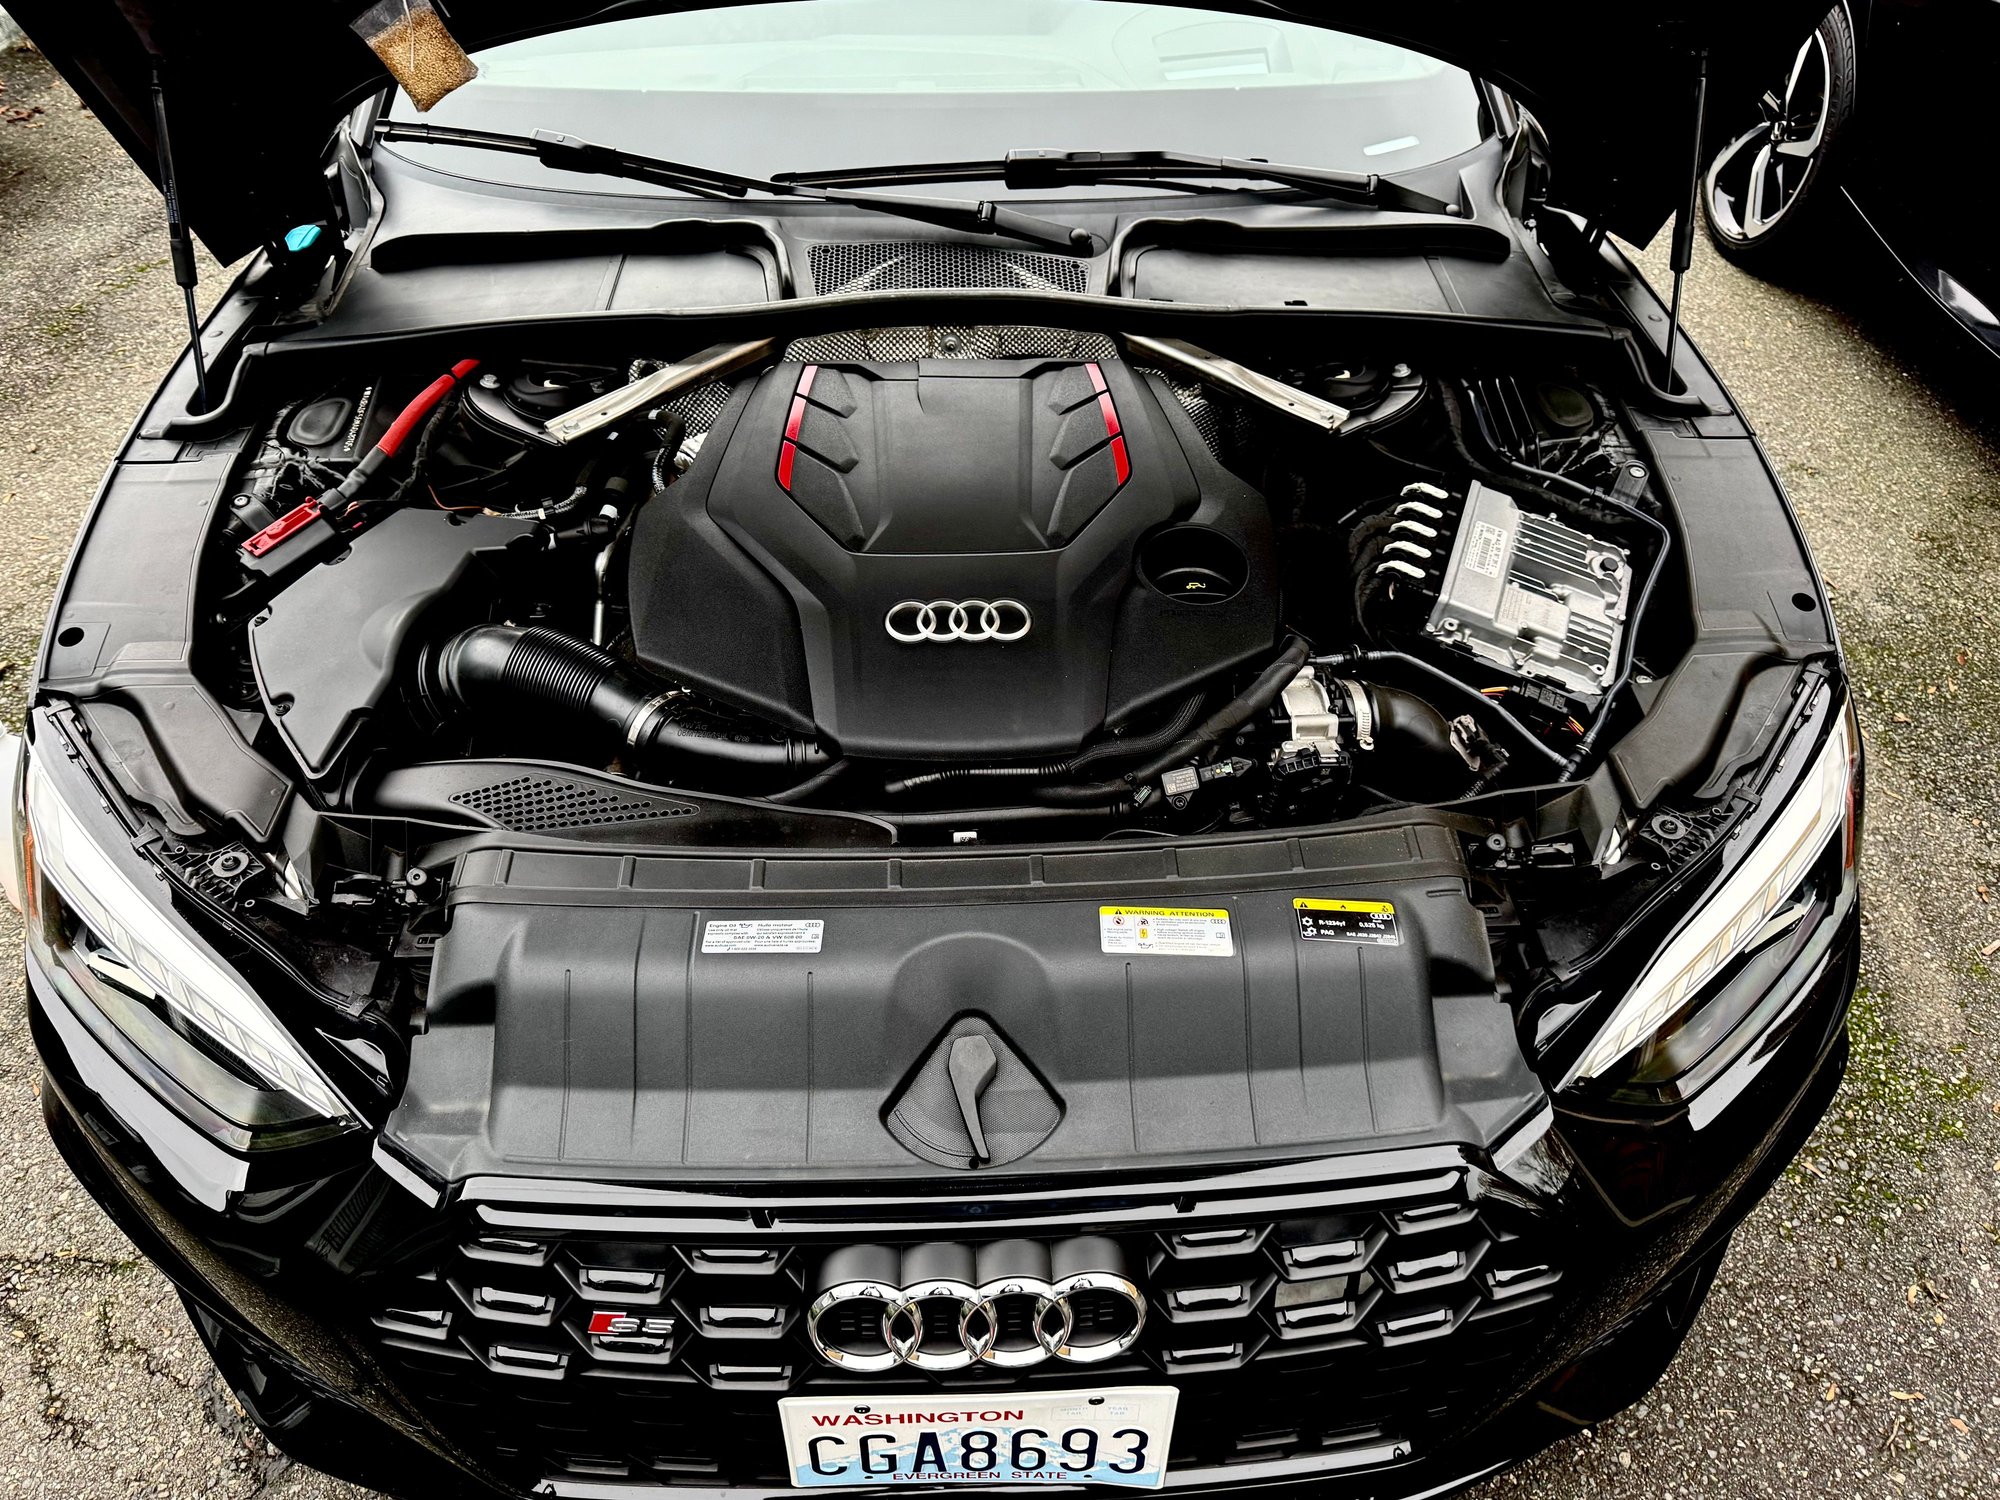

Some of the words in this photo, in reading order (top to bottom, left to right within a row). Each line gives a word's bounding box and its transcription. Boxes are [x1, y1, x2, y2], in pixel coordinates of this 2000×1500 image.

[606, 1317, 675, 1334] S5
[811, 1410, 1025, 1427] WASHINGTON
[807, 1427, 1150, 1477] CGA8693
[892, 1470, 1001, 1481] EVERGREEN
[1011, 1470, 1068, 1480] STATE
